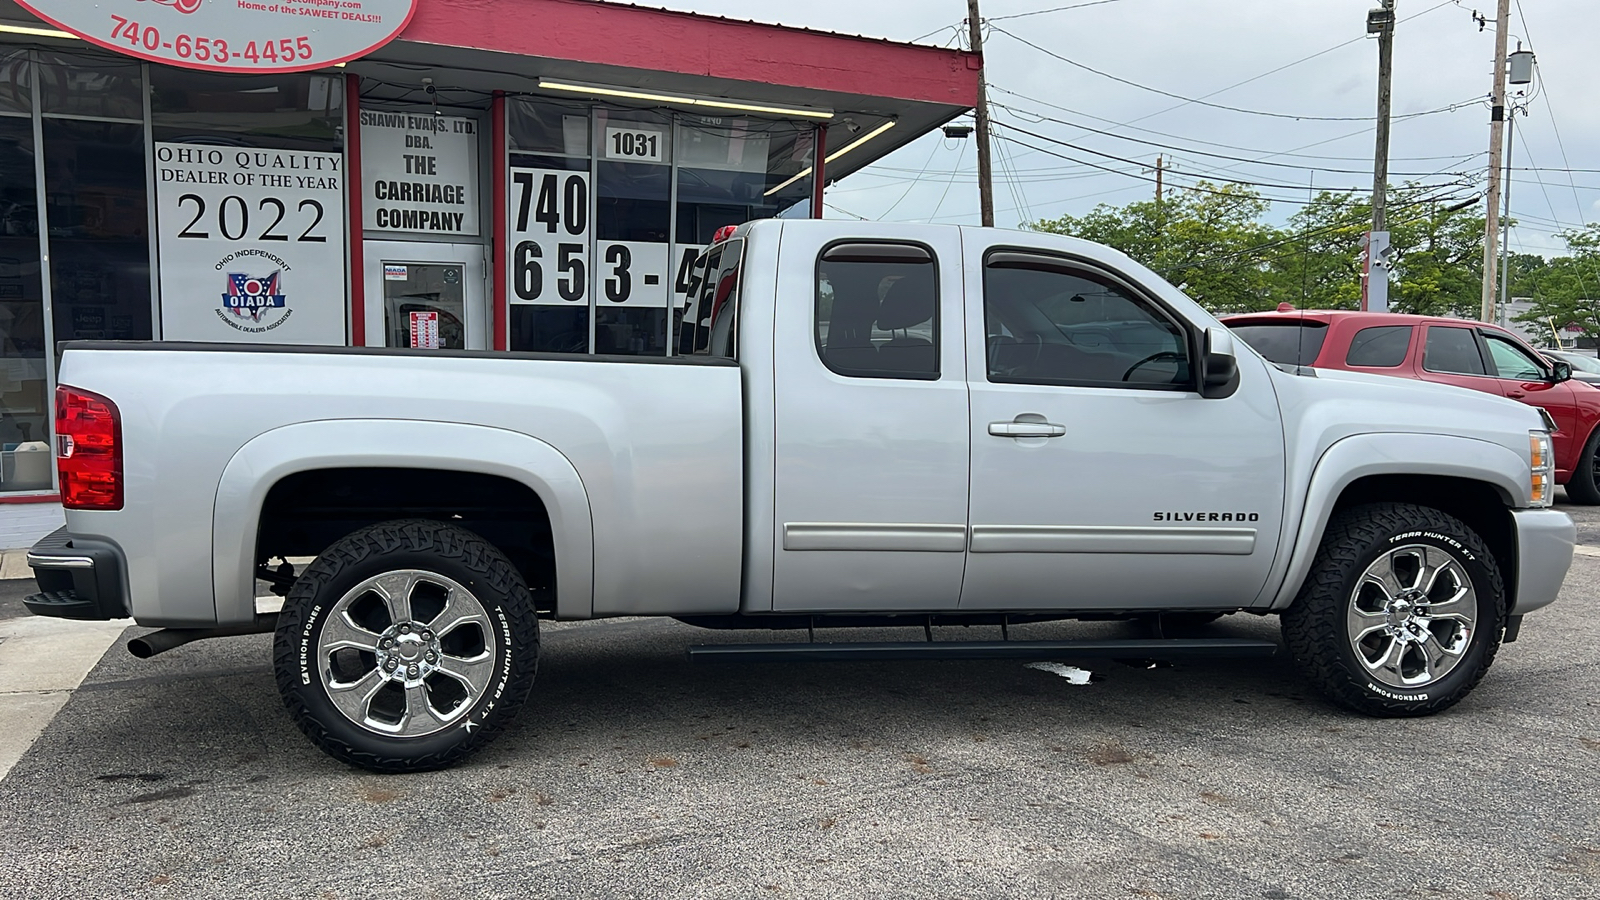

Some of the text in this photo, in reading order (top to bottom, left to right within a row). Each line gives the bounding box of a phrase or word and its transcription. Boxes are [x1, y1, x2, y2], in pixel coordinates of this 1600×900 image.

[237, 0, 382, 23] Home of the SAWEET DEALS!!!
[111, 14, 313, 63] 740-653-4455
[360, 112, 405, 128] SHAWN
[453, 120, 476, 135] LTD.
[405, 135, 433, 149] DBA.
[612, 132, 657, 157] 1031
[157, 147, 340, 170] OHIO QUALITY
[403, 155, 436, 175] THE
[161, 168, 338, 190] DEALER OF THE YEAR
[375, 180, 465, 205] CARRIAGE
[513, 172, 587, 236] 740
[177, 193, 327, 243] 2022
[376, 208, 464, 231] COMPANY
[215, 249, 292, 272] OHIO INDEPENDENT
[230, 296, 275, 307] OIADA
[215, 308, 243, 331] AUTOMOBILE
[266, 308, 293, 331] ASSOCIATION
[1153, 512, 1259, 522] SILVERADO
[1388, 531, 1422, 544] TERRA
[1423, 531, 1462, 549] HUNTER
[495, 605, 512, 646] TERRA
[300, 604, 322, 672] VENOM POWER
[494, 649, 512, 699] HUNTER
[1367, 682, 1419, 701] VENOM POWER
